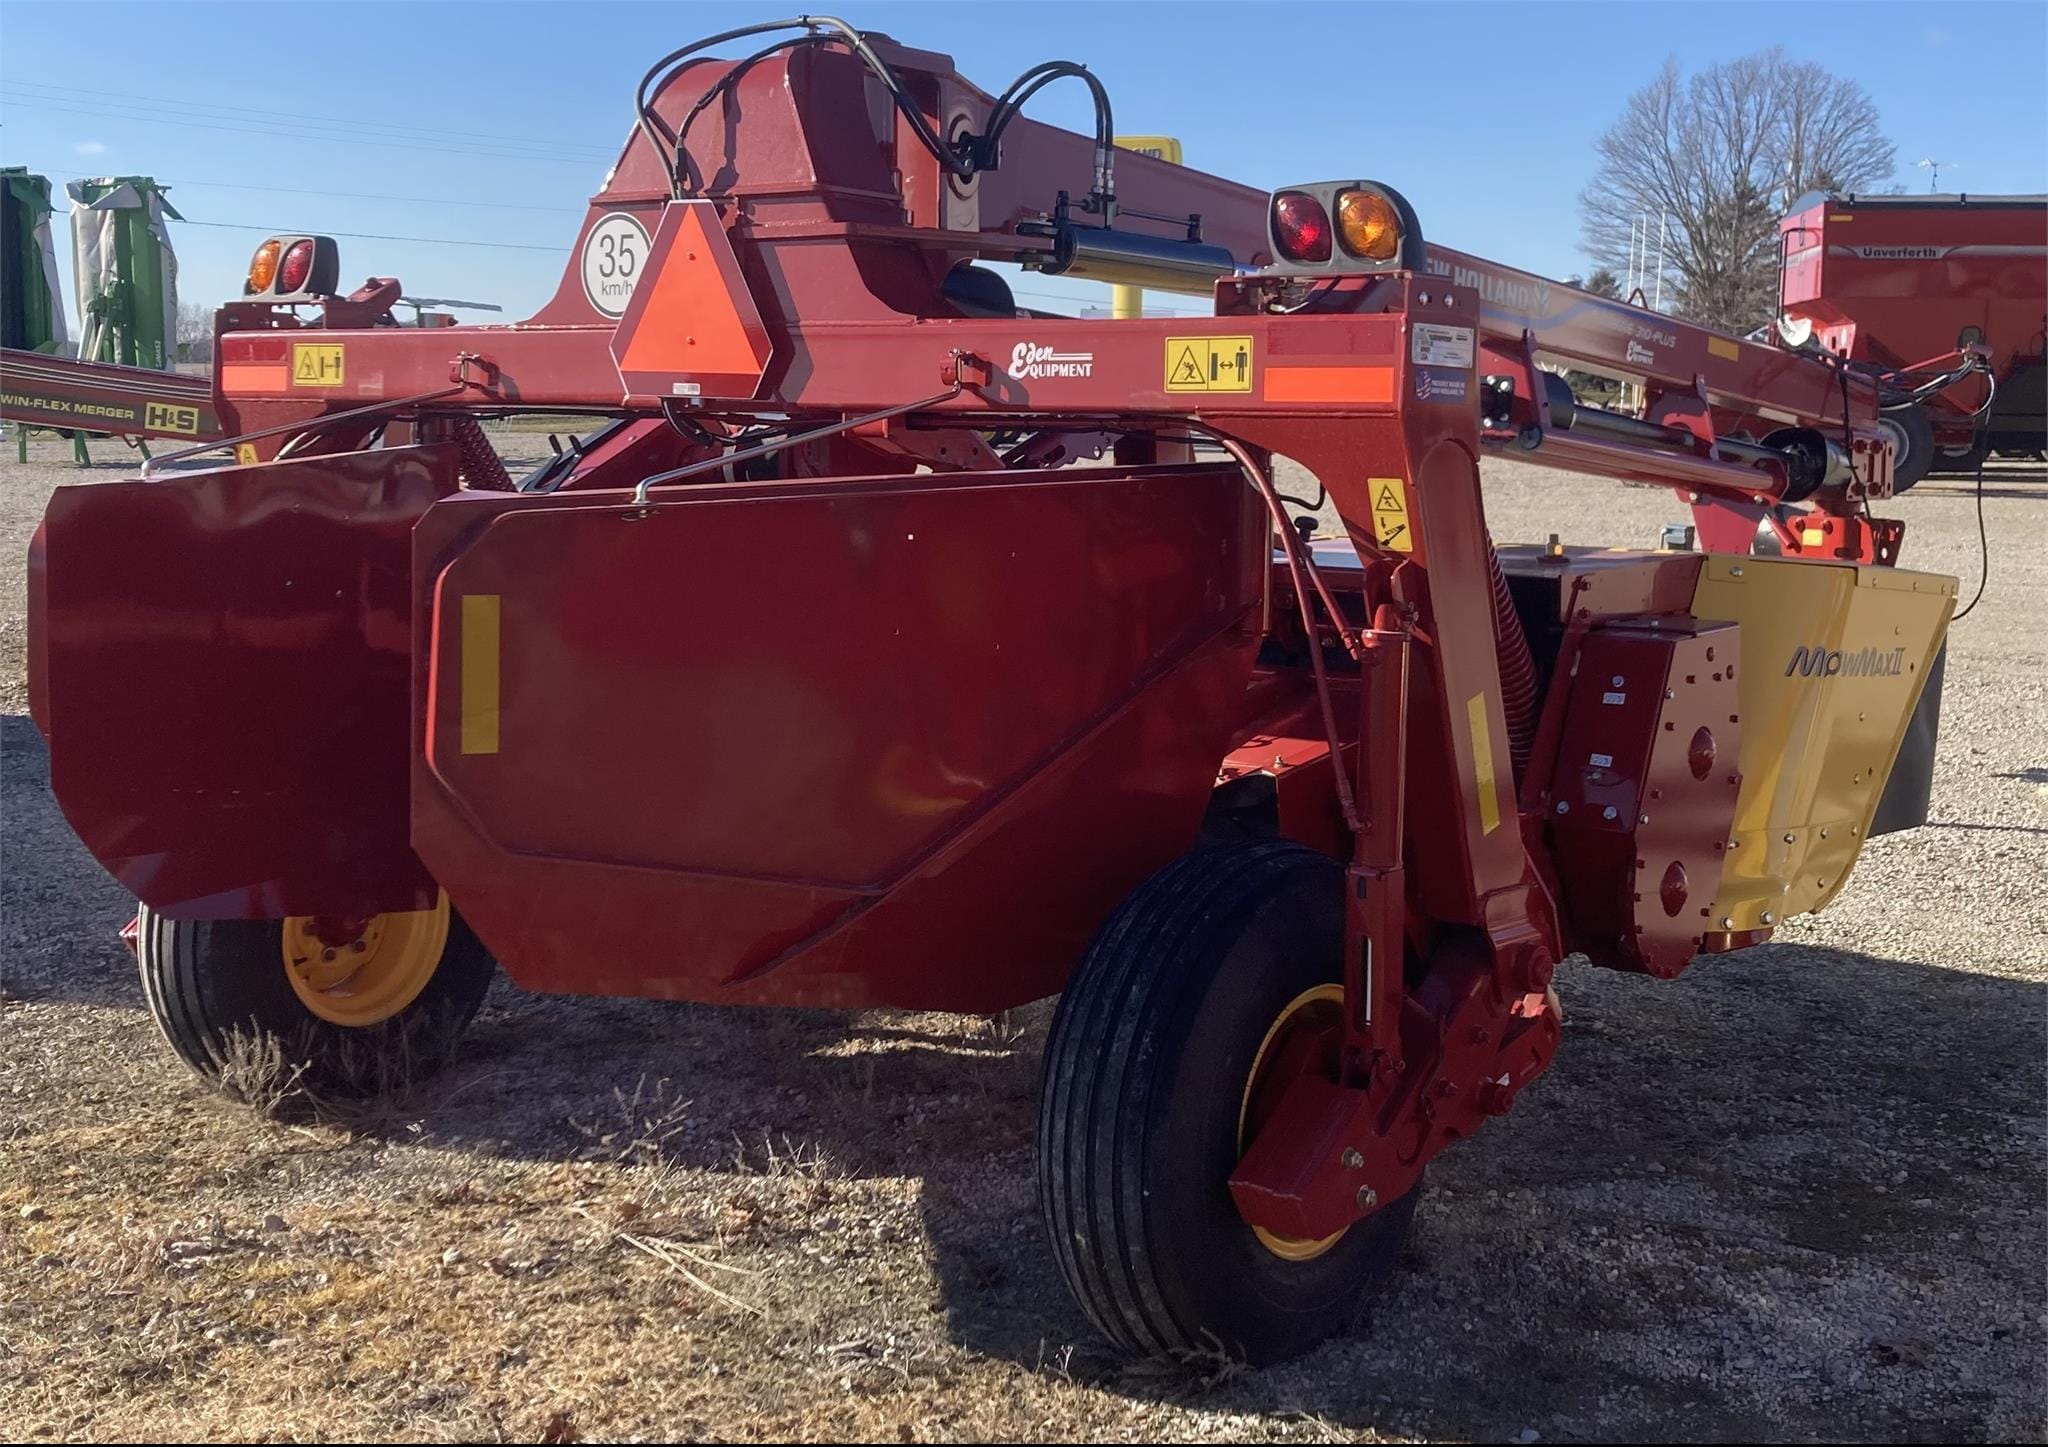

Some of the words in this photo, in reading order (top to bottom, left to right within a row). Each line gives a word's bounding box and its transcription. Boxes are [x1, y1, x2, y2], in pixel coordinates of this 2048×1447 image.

[599, 234, 635, 278] 35
[1863, 247, 1937, 257] Unverferth
[601, 280, 634, 296] km/h
[1008, 342, 1054, 380] Eden
[73, 403, 134, 420] MERGER
[149, 406, 196, 430] H&S
